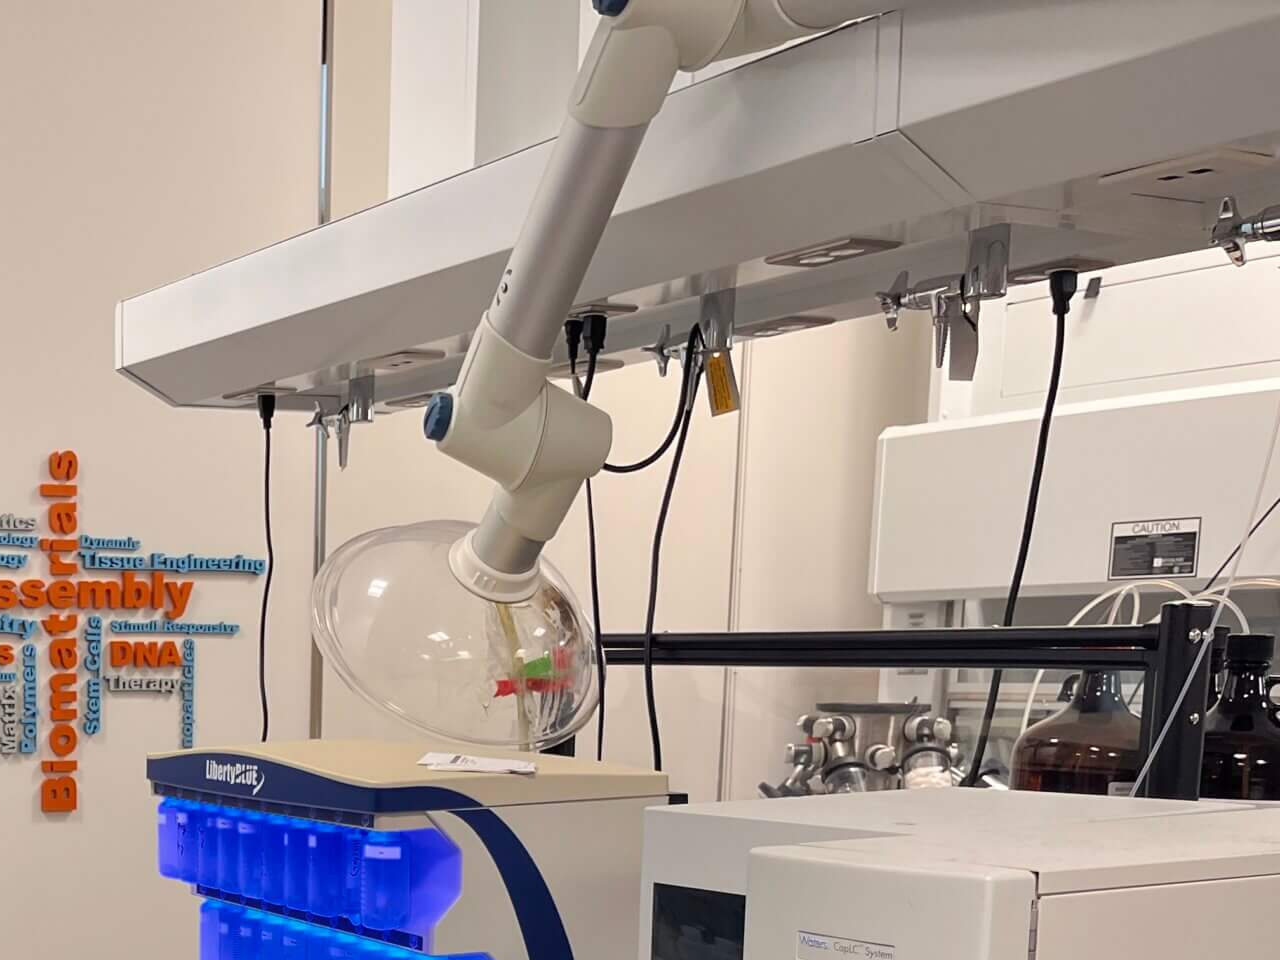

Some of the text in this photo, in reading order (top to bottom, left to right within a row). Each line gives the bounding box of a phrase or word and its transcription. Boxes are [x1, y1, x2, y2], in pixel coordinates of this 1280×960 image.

[1132, 522, 1180, 534] CAUTION
[79, 535, 141, 550] Dynamic
[78, 550, 266, 575] Tissue Engineering
[111, 620, 240, 637] Stimuli Responsive
[110, 641, 182, 668] DNA
[84, 616, 101, 736] Stem Cells
[105, 675, 181, 694] Therapy
[21, 644, 37, 753] Polymers
[182, 639, 194, 748] noparticles
[0, 685, 16, 755] Matrix
[865, 946, 893, 959] System
